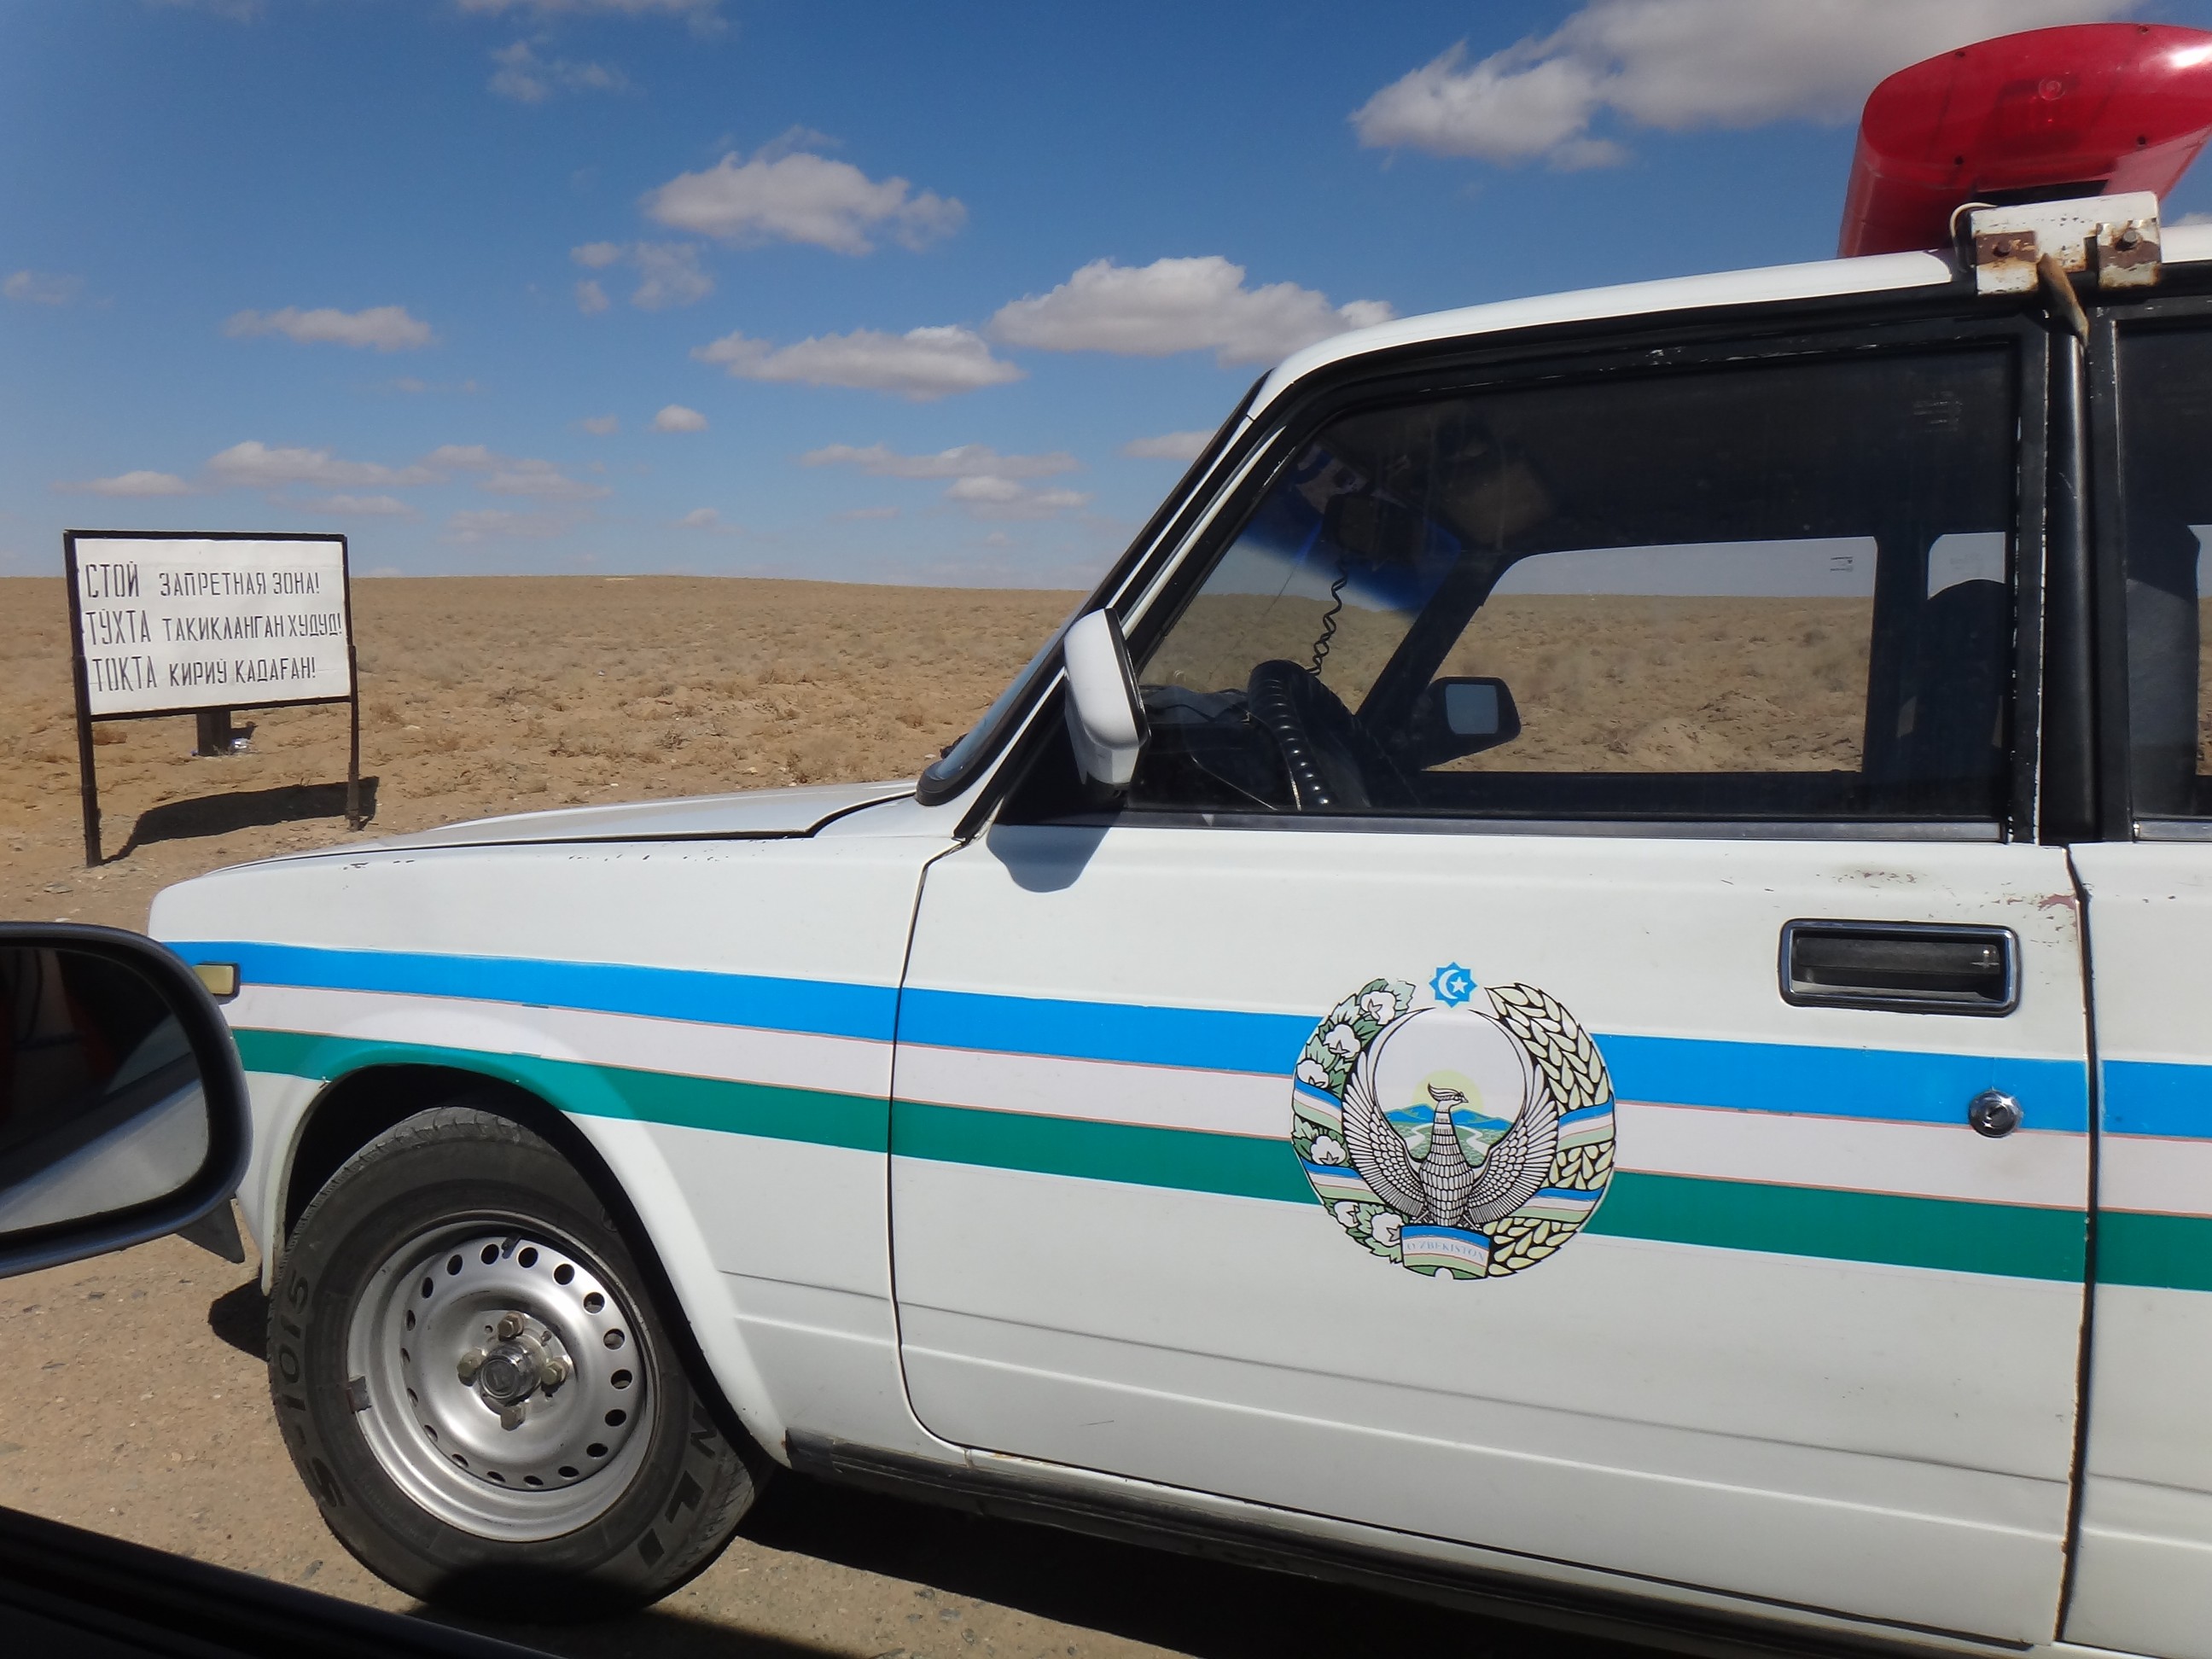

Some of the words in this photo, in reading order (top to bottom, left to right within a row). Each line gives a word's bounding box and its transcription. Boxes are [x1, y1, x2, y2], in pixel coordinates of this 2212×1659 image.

[85, 562, 139, 597] СТОЙ
[160, 573, 266, 596] ЗАПРЕТНАЯ
[273, 573, 320, 594] ЗОНА!
